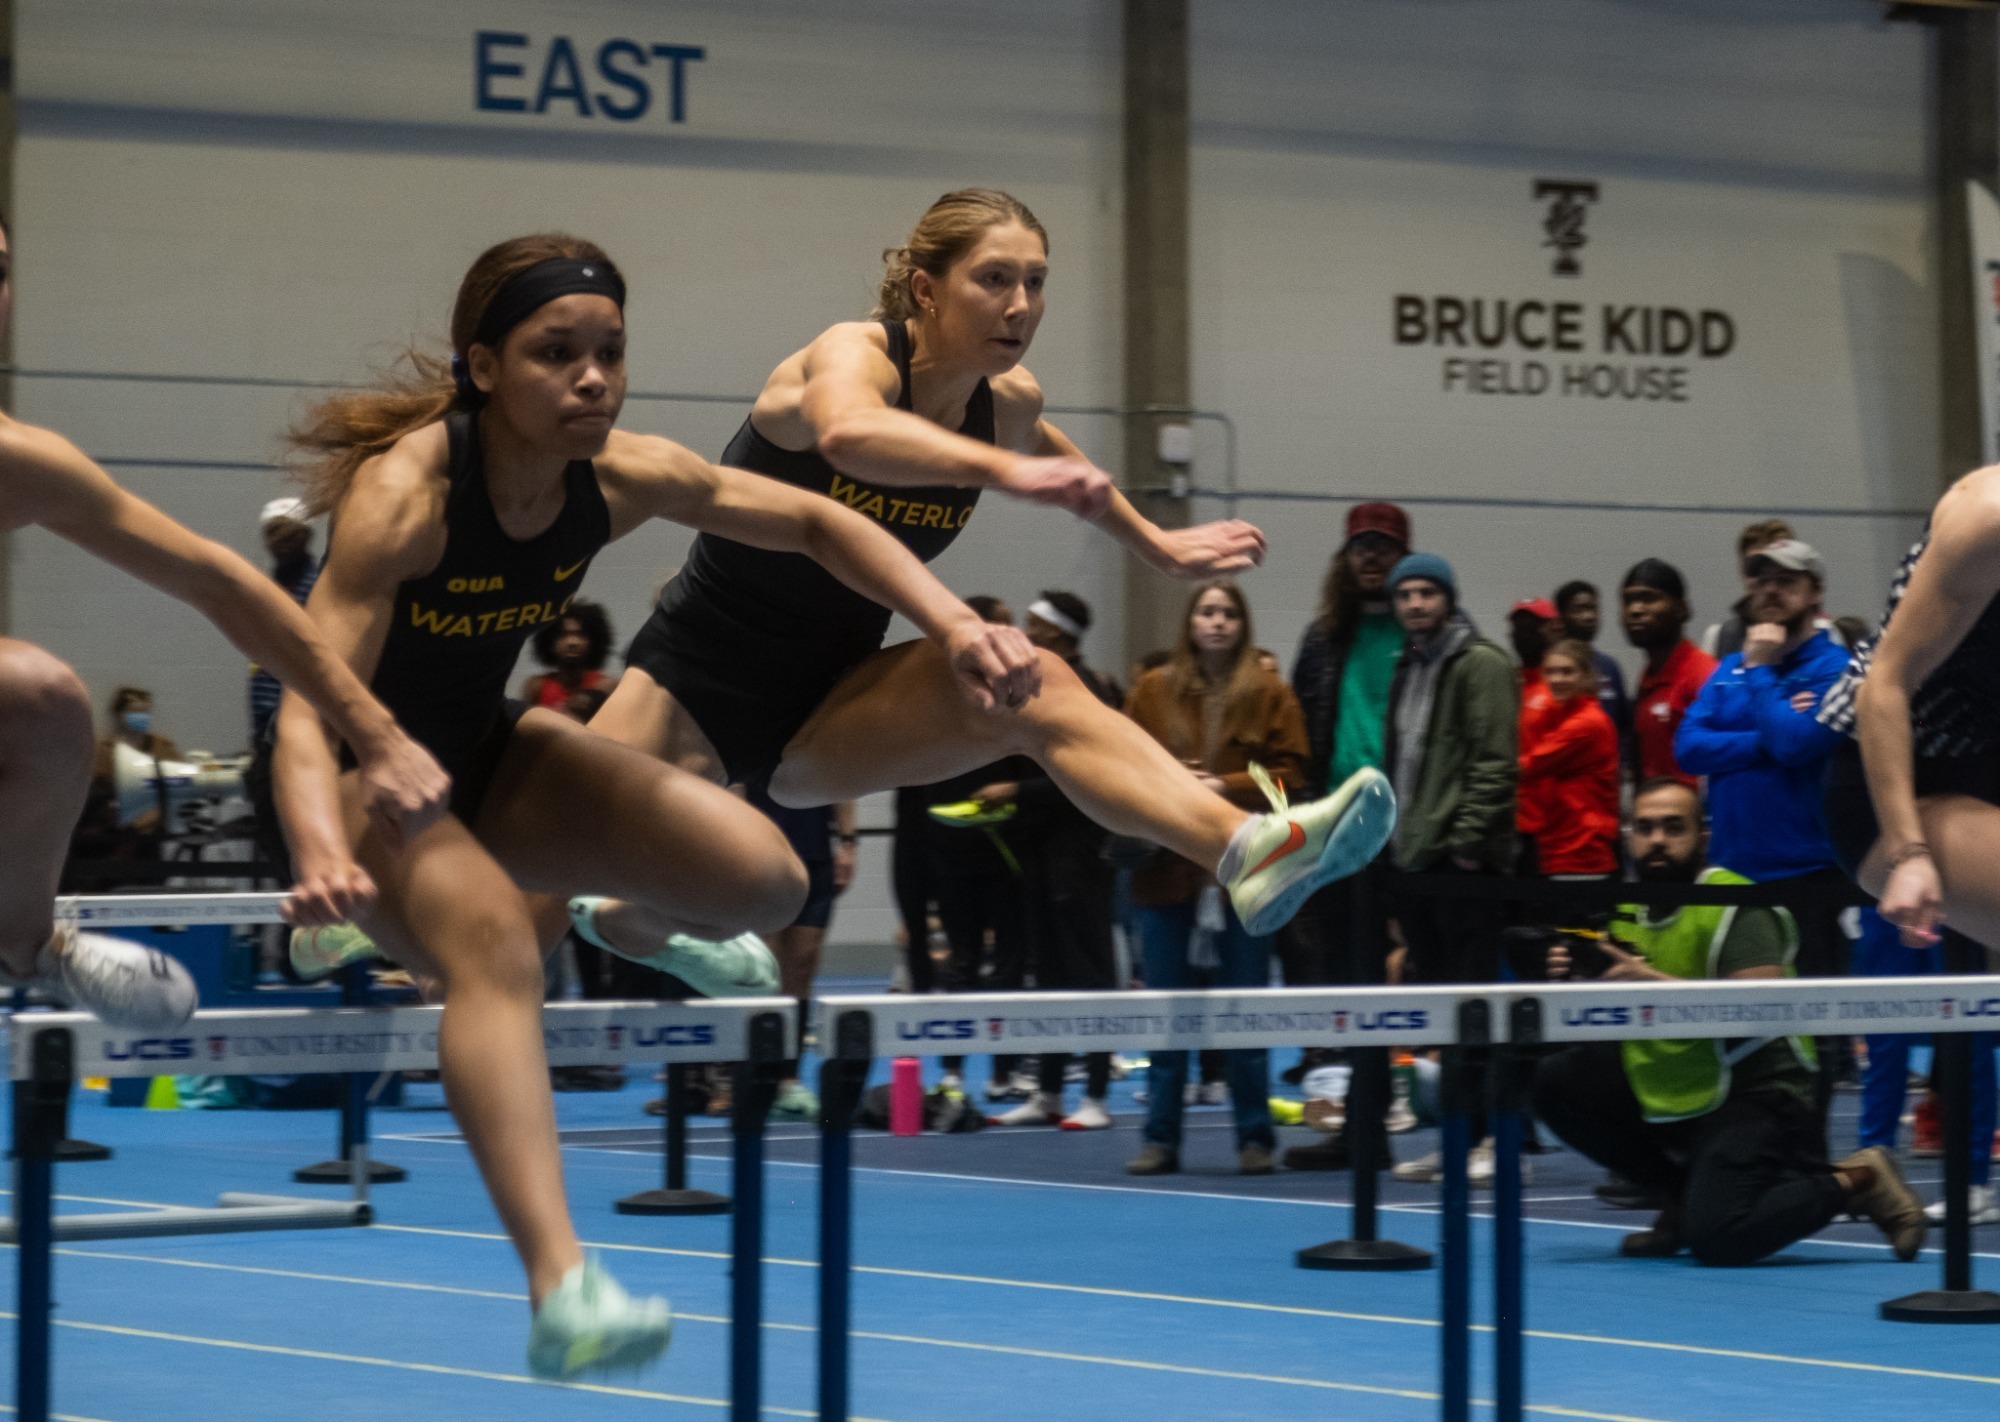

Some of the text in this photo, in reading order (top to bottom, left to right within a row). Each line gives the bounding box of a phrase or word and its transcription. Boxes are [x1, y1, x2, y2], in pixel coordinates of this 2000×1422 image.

[474, 31, 706, 124] EAST
[1394, 296, 1736, 358] BRUCE KIDD
[1443, 357, 1689, 401] FIELD HOUSE
[447, 576, 505, 593] OUA
[896, 1019, 976, 1041] UCS
[1355, 1010, 1429, 1031] UCS
[1561, 1006, 1631, 1027] UCS
[102, 1037, 195, 1061] UCS
[632, 1024, 716, 1047] UCS
